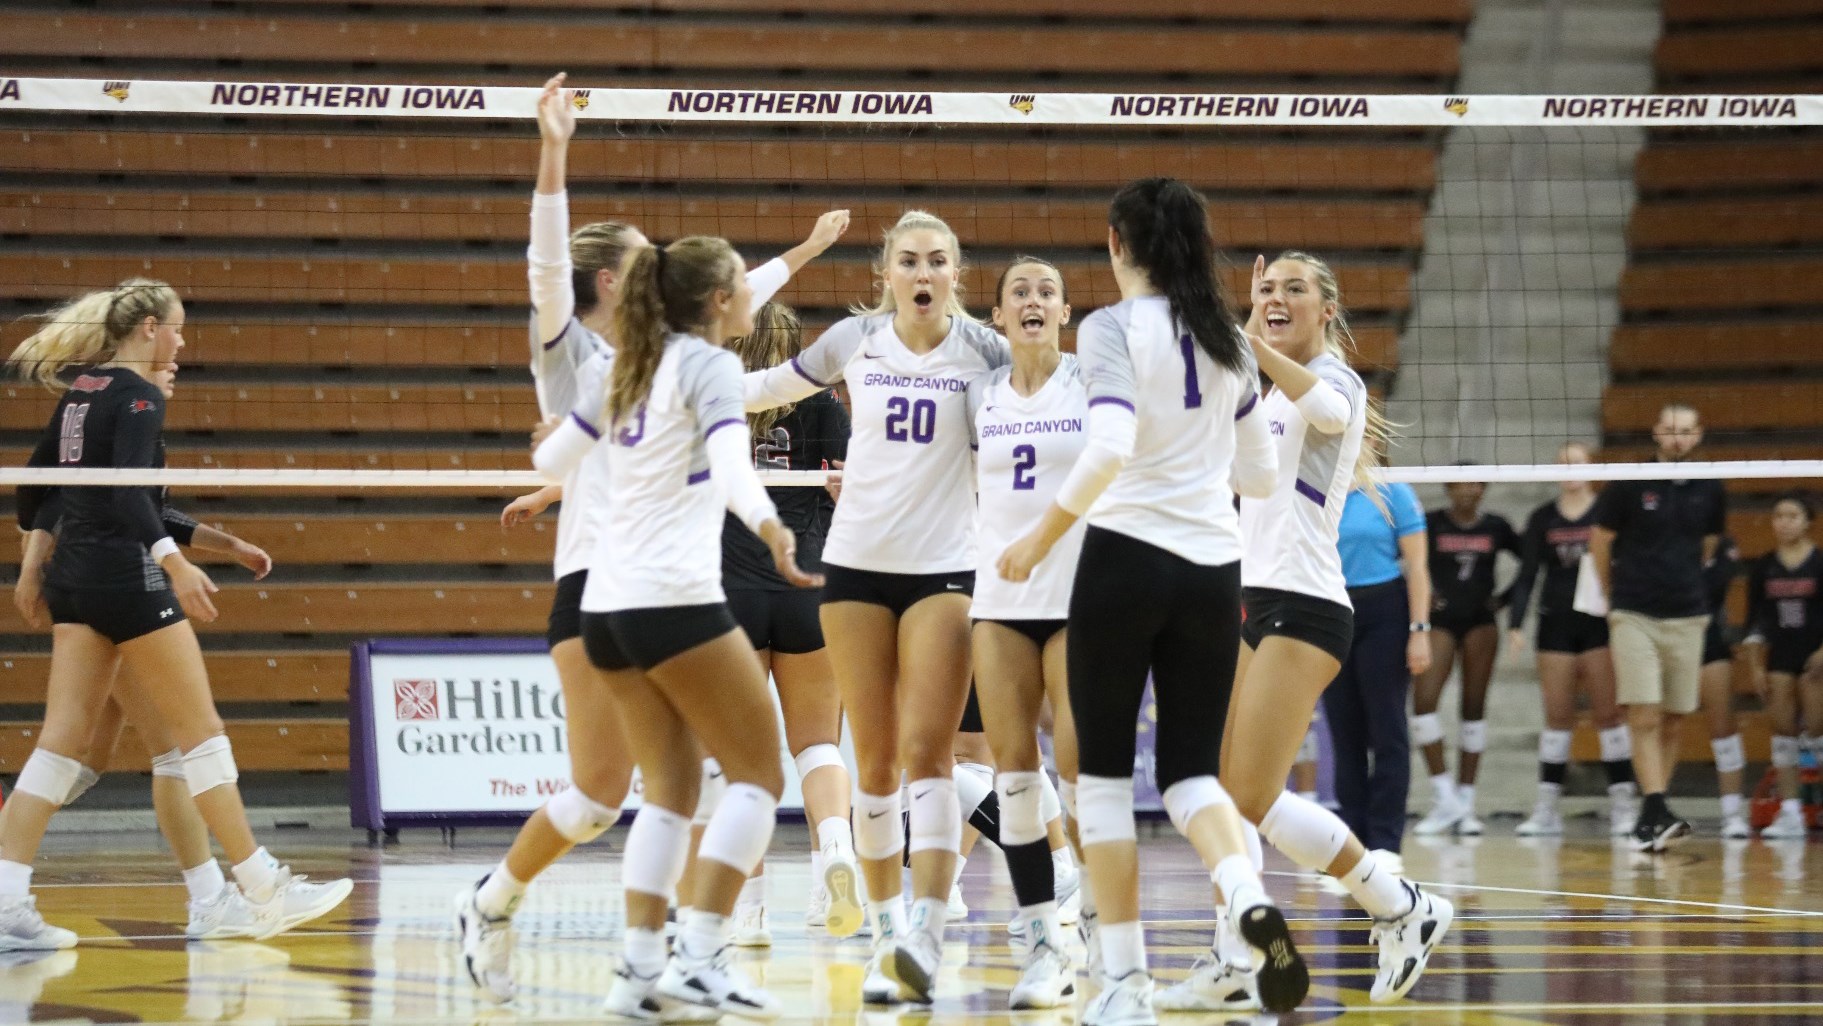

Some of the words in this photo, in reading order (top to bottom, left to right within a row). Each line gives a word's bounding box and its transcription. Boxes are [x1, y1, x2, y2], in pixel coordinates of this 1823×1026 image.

[211, 83, 390, 108] NORTHERN
[401, 87, 485, 110] IOWA
[668, 91, 842, 114] NORTHERN
[851, 94, 933, 115] IOWA
[1009, 94, 1035, 106] UNI
[1110, 96, 1279, 117] NORTHERN
[1289, 97, 1369, 117] IOWA
[1542, 98, 1708, 118] NORTHERN
[1718, 98, 1797, 118] IOWA
[864, 373, 911, 388] GRAND
[914, 377, 969, 393] CANYON
[1180, 334, 1202, 410] 1
[885, 396, 937, 444] 20
[982, 422, 1022, 438] GRAND
[1025, 418, 1082, 434] CANYON
[1012, 444, 1036, 490] 2
[397, 725, 543, 755] Garden
[490, 779, 527, 796] The
